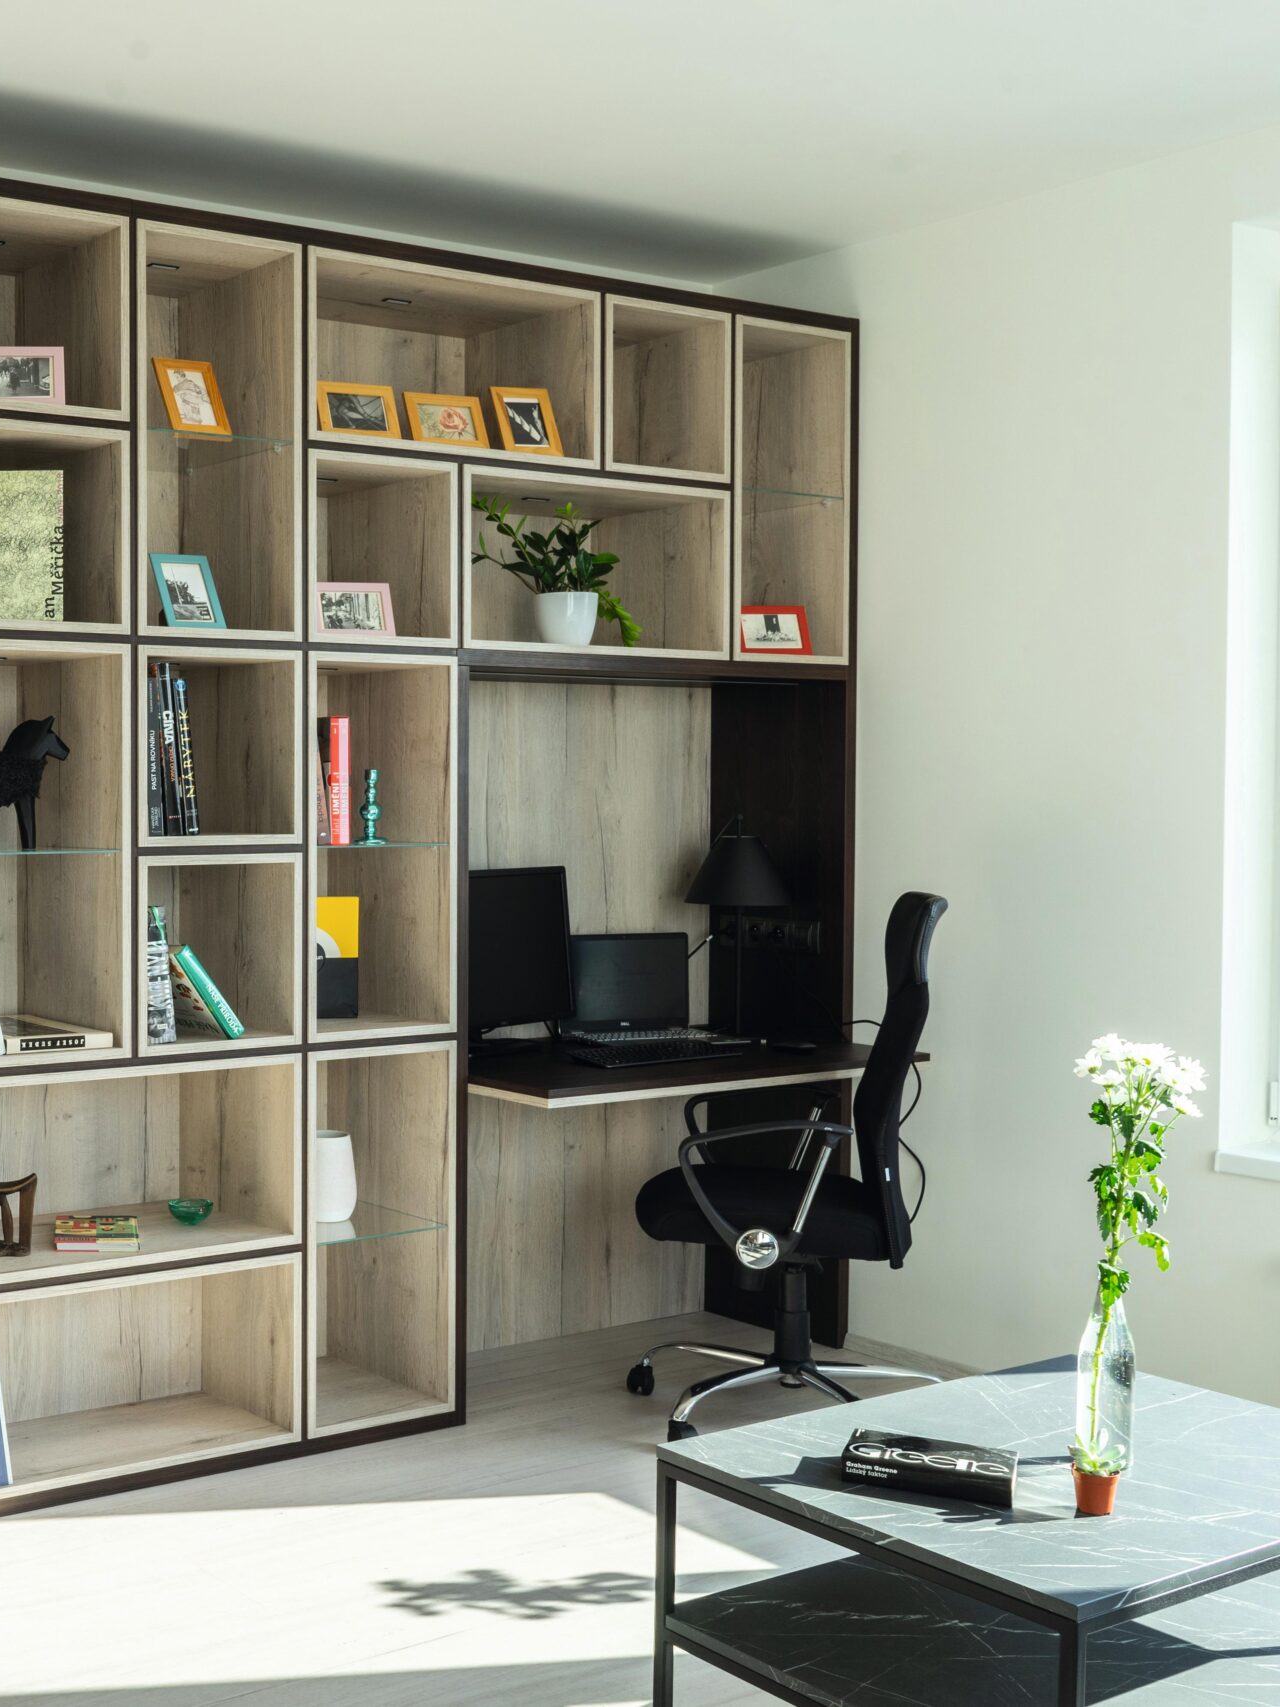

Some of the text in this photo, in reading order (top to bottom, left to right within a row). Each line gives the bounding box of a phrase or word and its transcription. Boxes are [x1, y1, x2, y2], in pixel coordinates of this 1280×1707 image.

[44, 596, 55, 619] an
[50, 525, 64, 596] Měřička
[149, 729, 157, 760] ROVNÍKU
[179, 709, 196, 798] NÁBYTEK
[151, 761, 157, 773] NA
[21, 1041, 52, 1049] SUDEK
[845, 1461, 898, 1474] Graham Greene
[846, 1467, 867, 1476] Lidský
